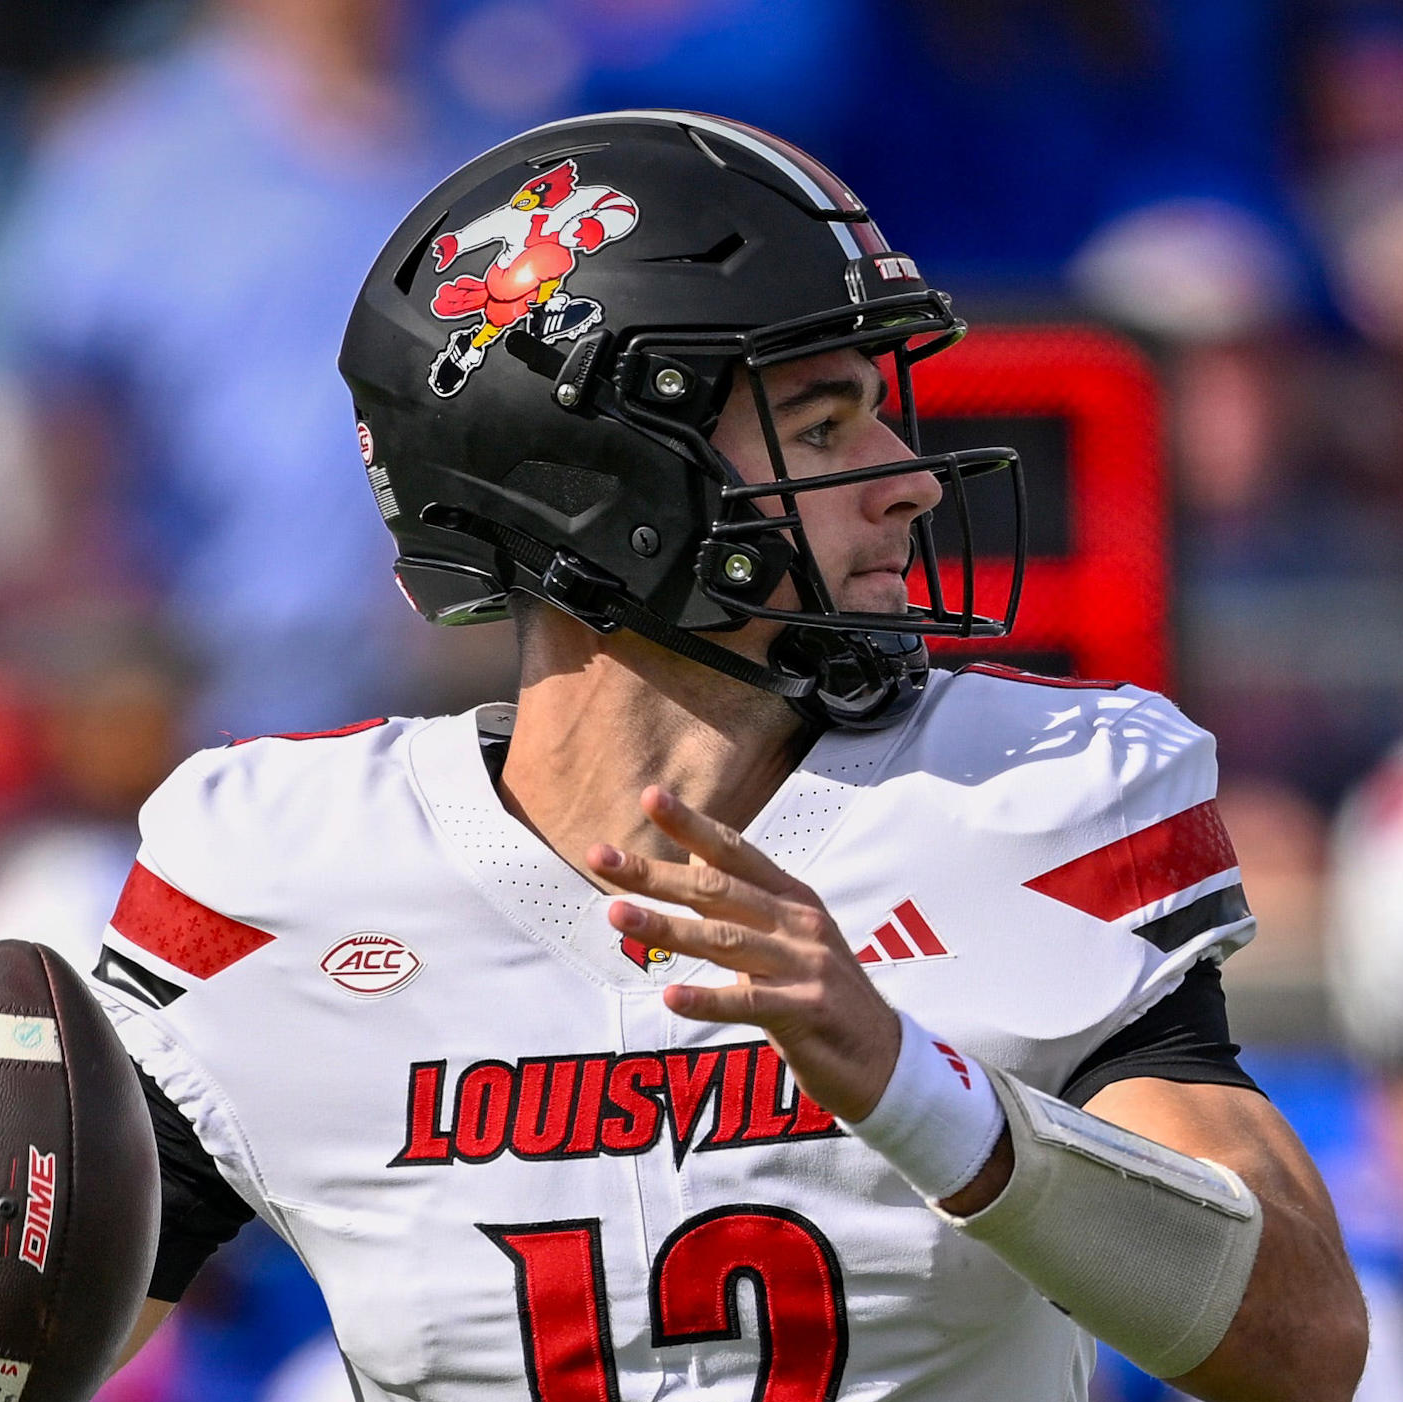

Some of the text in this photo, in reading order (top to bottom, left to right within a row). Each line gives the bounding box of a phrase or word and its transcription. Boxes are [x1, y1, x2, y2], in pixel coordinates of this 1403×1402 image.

[524, 214, 560, 248] L
[335, 949, 405, 971] ACC
[386, 1040, 852, 1172] LOUISVILL
[18, 1144, 56, 1274] DIME
